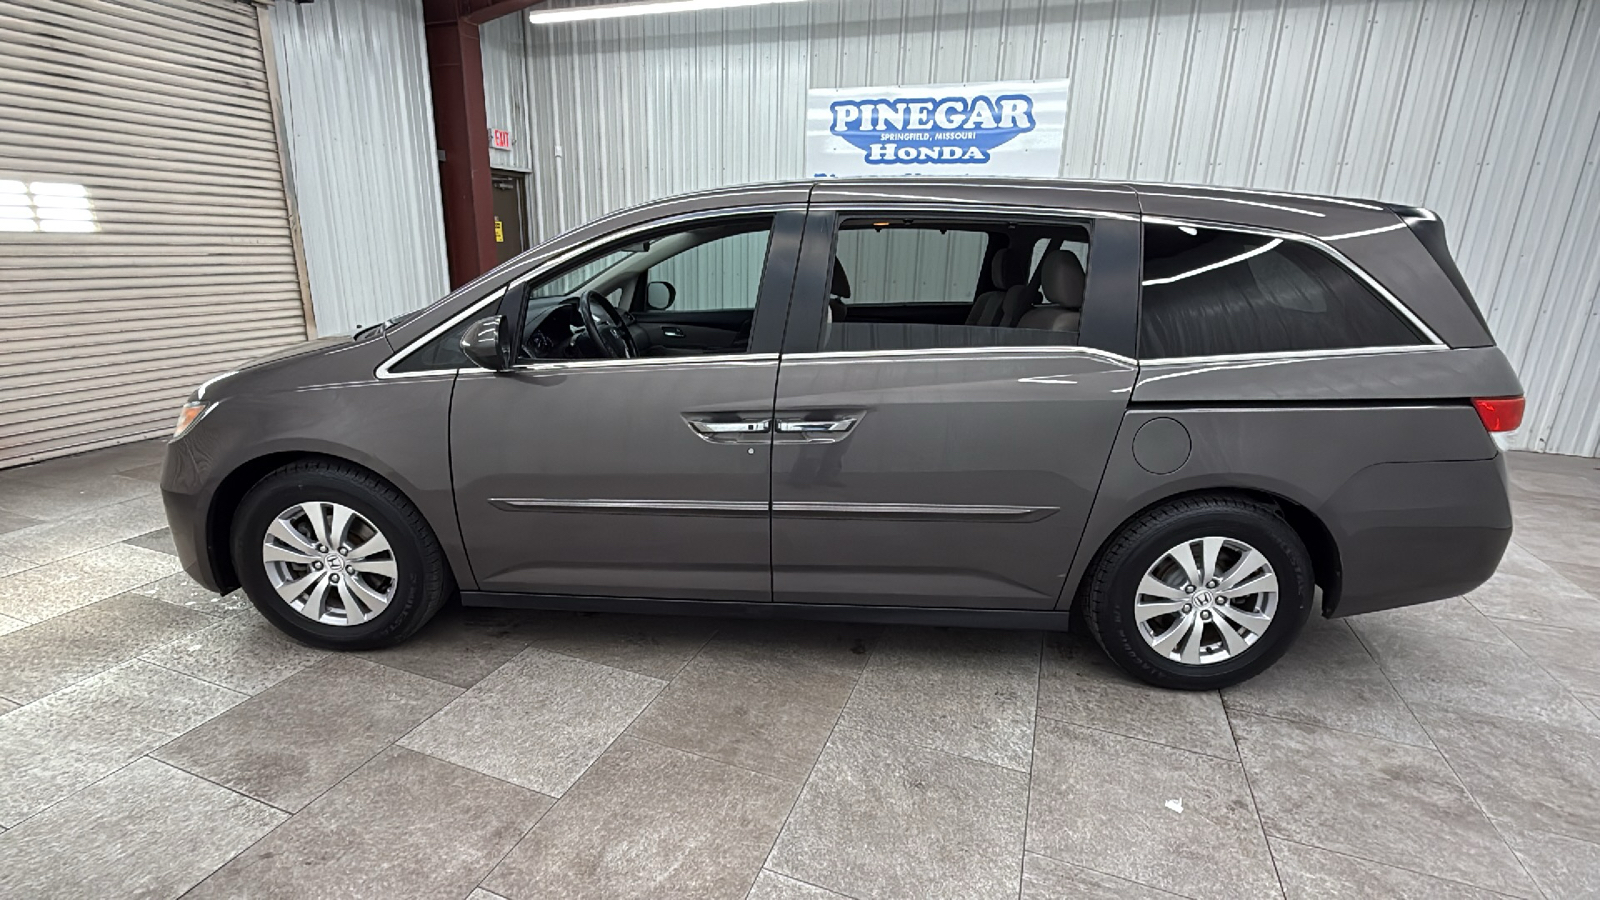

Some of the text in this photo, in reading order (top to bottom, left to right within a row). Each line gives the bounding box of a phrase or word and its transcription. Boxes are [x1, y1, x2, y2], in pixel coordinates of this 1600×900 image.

[834, 98, 1031, 132] PINEGAR
[494, 129, 509, 147] EXIT
[880, 131, 976, 141] SPRINGFIELD, MISSOURI
